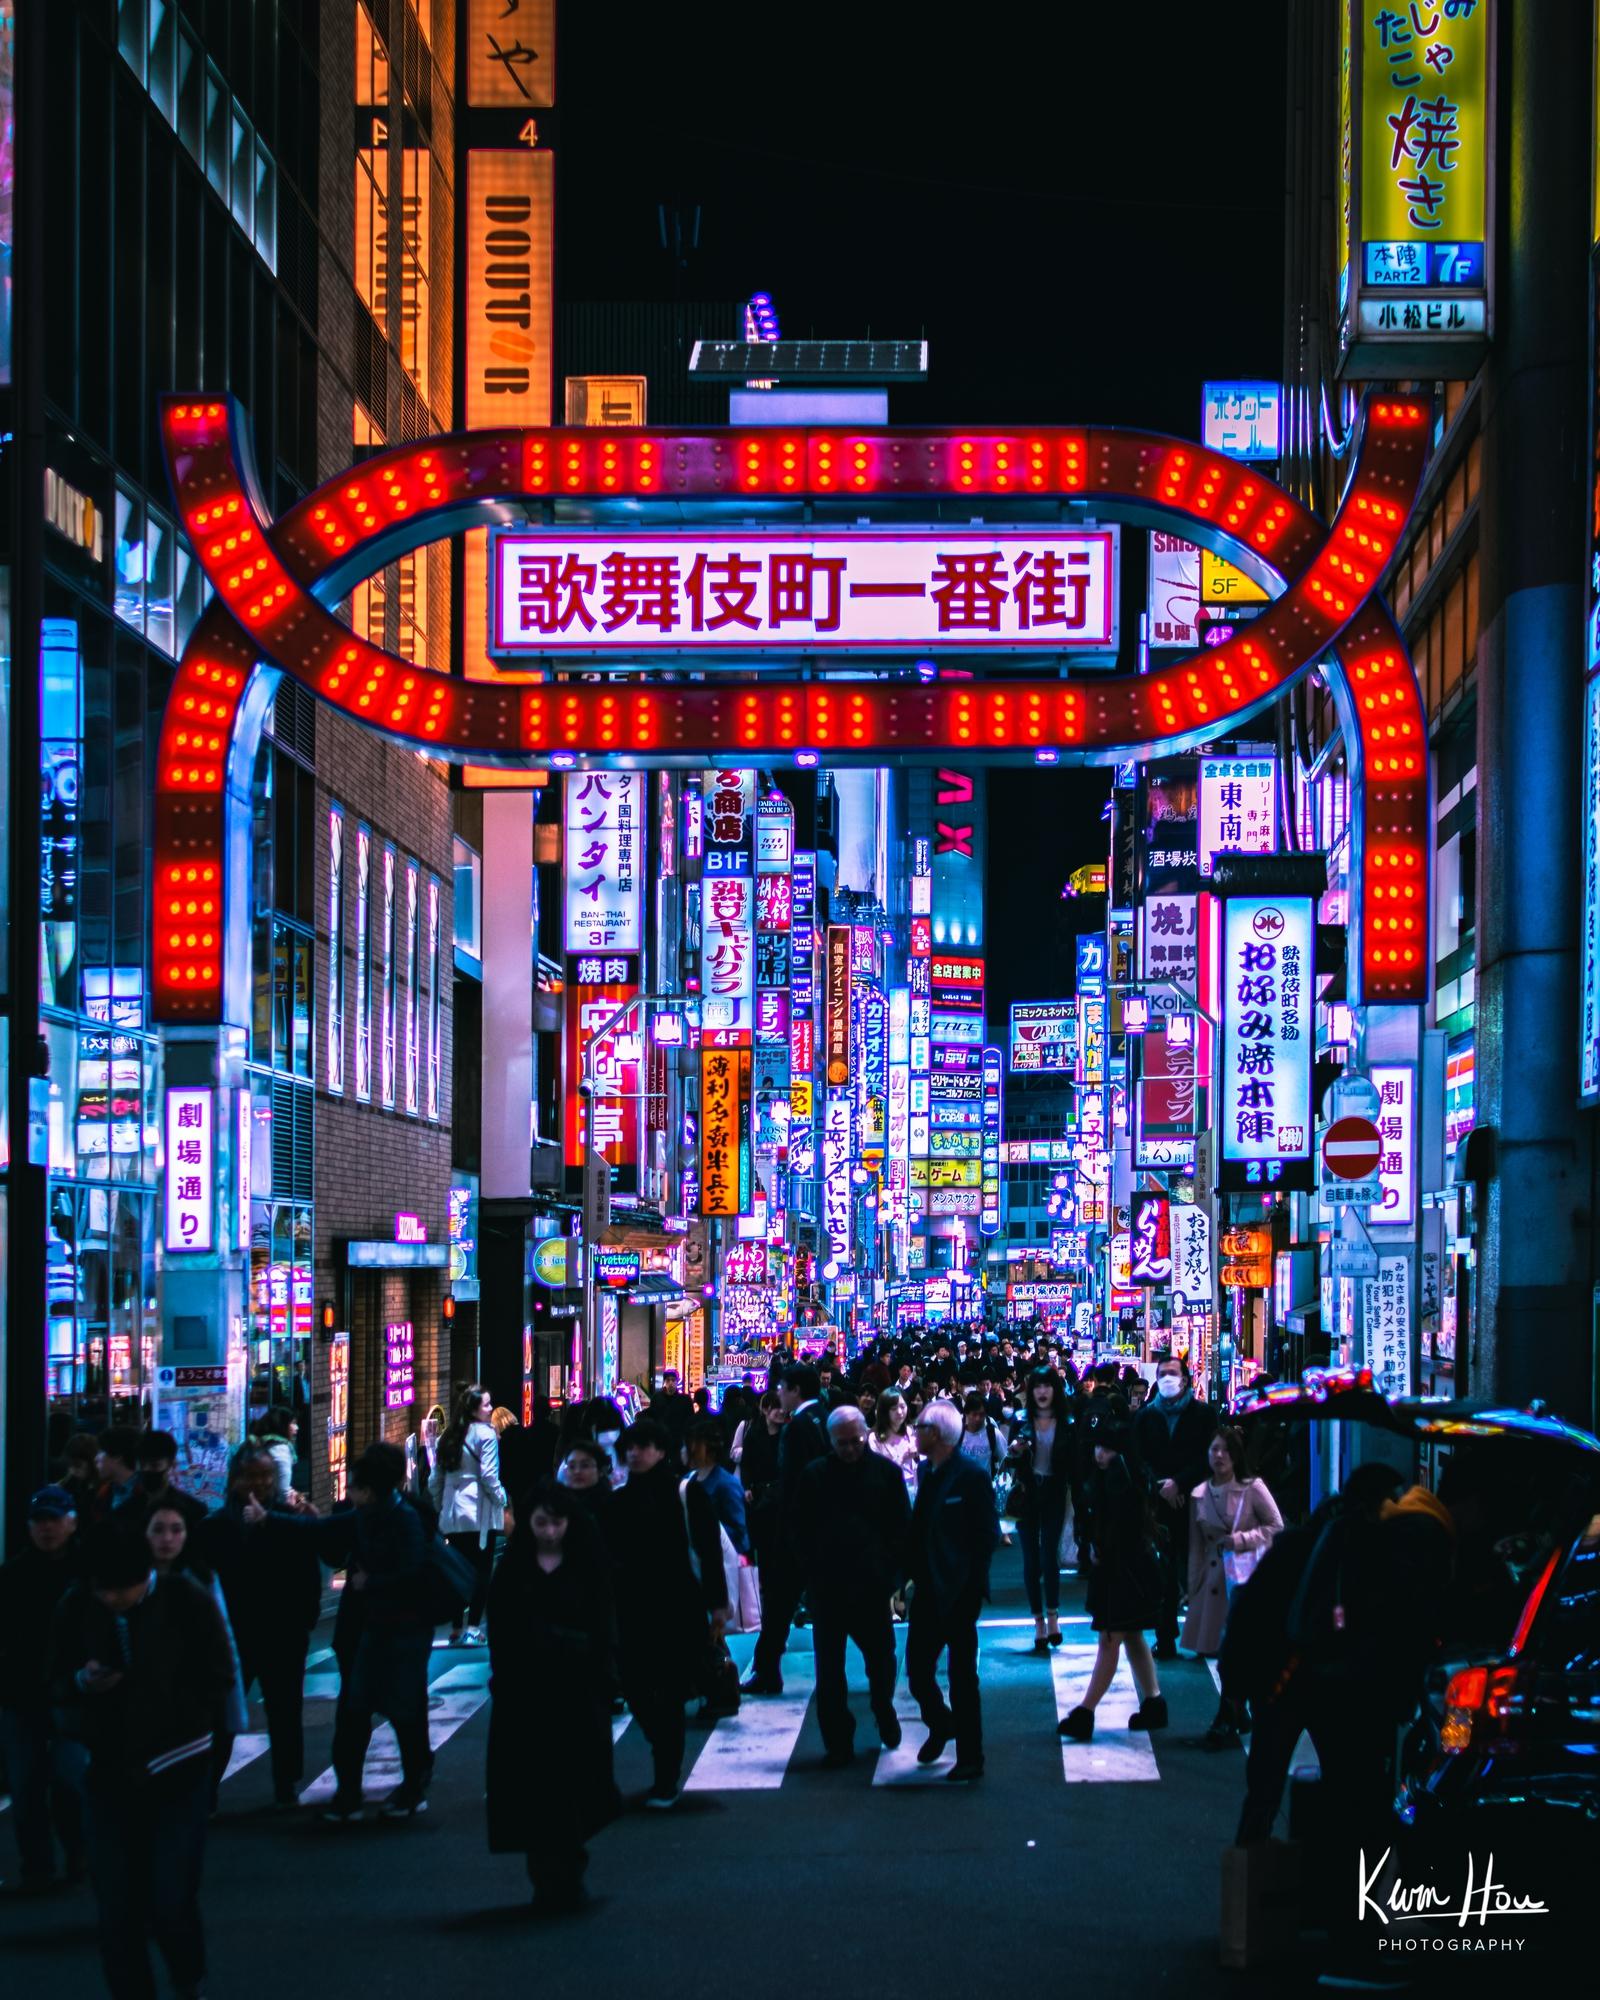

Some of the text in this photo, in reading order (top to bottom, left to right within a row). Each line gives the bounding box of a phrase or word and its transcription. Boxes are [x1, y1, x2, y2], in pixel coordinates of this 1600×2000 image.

[518, 119, 539, 147] 4
[1374, 245, 1417, 267] 本陣
[1434, 245, 1472, 282] 7F
[1374, 267, 1421, 282] PART2
[484, 195, 536, 394] DOUTOR
[1379, 304, 1466, 329] 小松ビル
[517, 550, 1092, 634] 歌舞伎町一番街
[1211, 578, 1239, 595] 5F
[1205, 763, 1272, 779] 全卓全自動
[1219, 782, 1242, 851] 東南
[1246, 809, 1258, 843] 専門
[576, 774, 613, 902] バンタイ
[618, 774, 632, 893] タイ国料理専門店
[707, 851, 749, 870] B1F
[574, 919, 632, 928] RESTAURANT
[580, 911, 626, 919] BAN-THAI
[589, 931, 616, 945] 3F
[706, 880, 750, 994] 熟女キャバクラ
[758, 936, 770, 945] 3F
[578, 958, 628, 983] 焼肉
[773, 936, 787, 985] レンタル
[933, 963, 981, 979] 全店営業中
[833, 943, 844, 1054] 個室ダイニング居酒屋
[1280, 945, 1301, 1041] 歌舞伎町名物
[921, 1000, 929, 1033] カラオケ
[932, 1021, 981, 1031] FACE
[713, 1031, 740, 1046] 4F
[866, 1002, 883, 1073] カラオケ
[1236, 942, 1277, 1144] お好み焼本陣
[890, 1069, 907, 1152] カラオケ
[1379, 1080, 1404, 1210] 劇場通り
[176, 1102, 202, 1238] 劇場通り
[931, 1168, 962, 1182] ゲーム
[1246, 1160, 1281, 1183] 2F
[1326, 1187, 1380, 1203] 自転車を除く
[1018, 1249, 1050, 1259] コーヒー
[1184, 1212, 1209, 1291] お好み焼き
[1014, 1284, 1070, 1295] 無料案内所
[1365, 1283, 1373, 1315] Security
[1191, 1303, 1212, 1314] B1F
[1373, 1285, 1381, 1330] Your Safety
[1381, 1269, 1396, 1388] 防犯カメラ作動中
[1394, 1262, 1407, 1394] みなさまの安全を守ります
